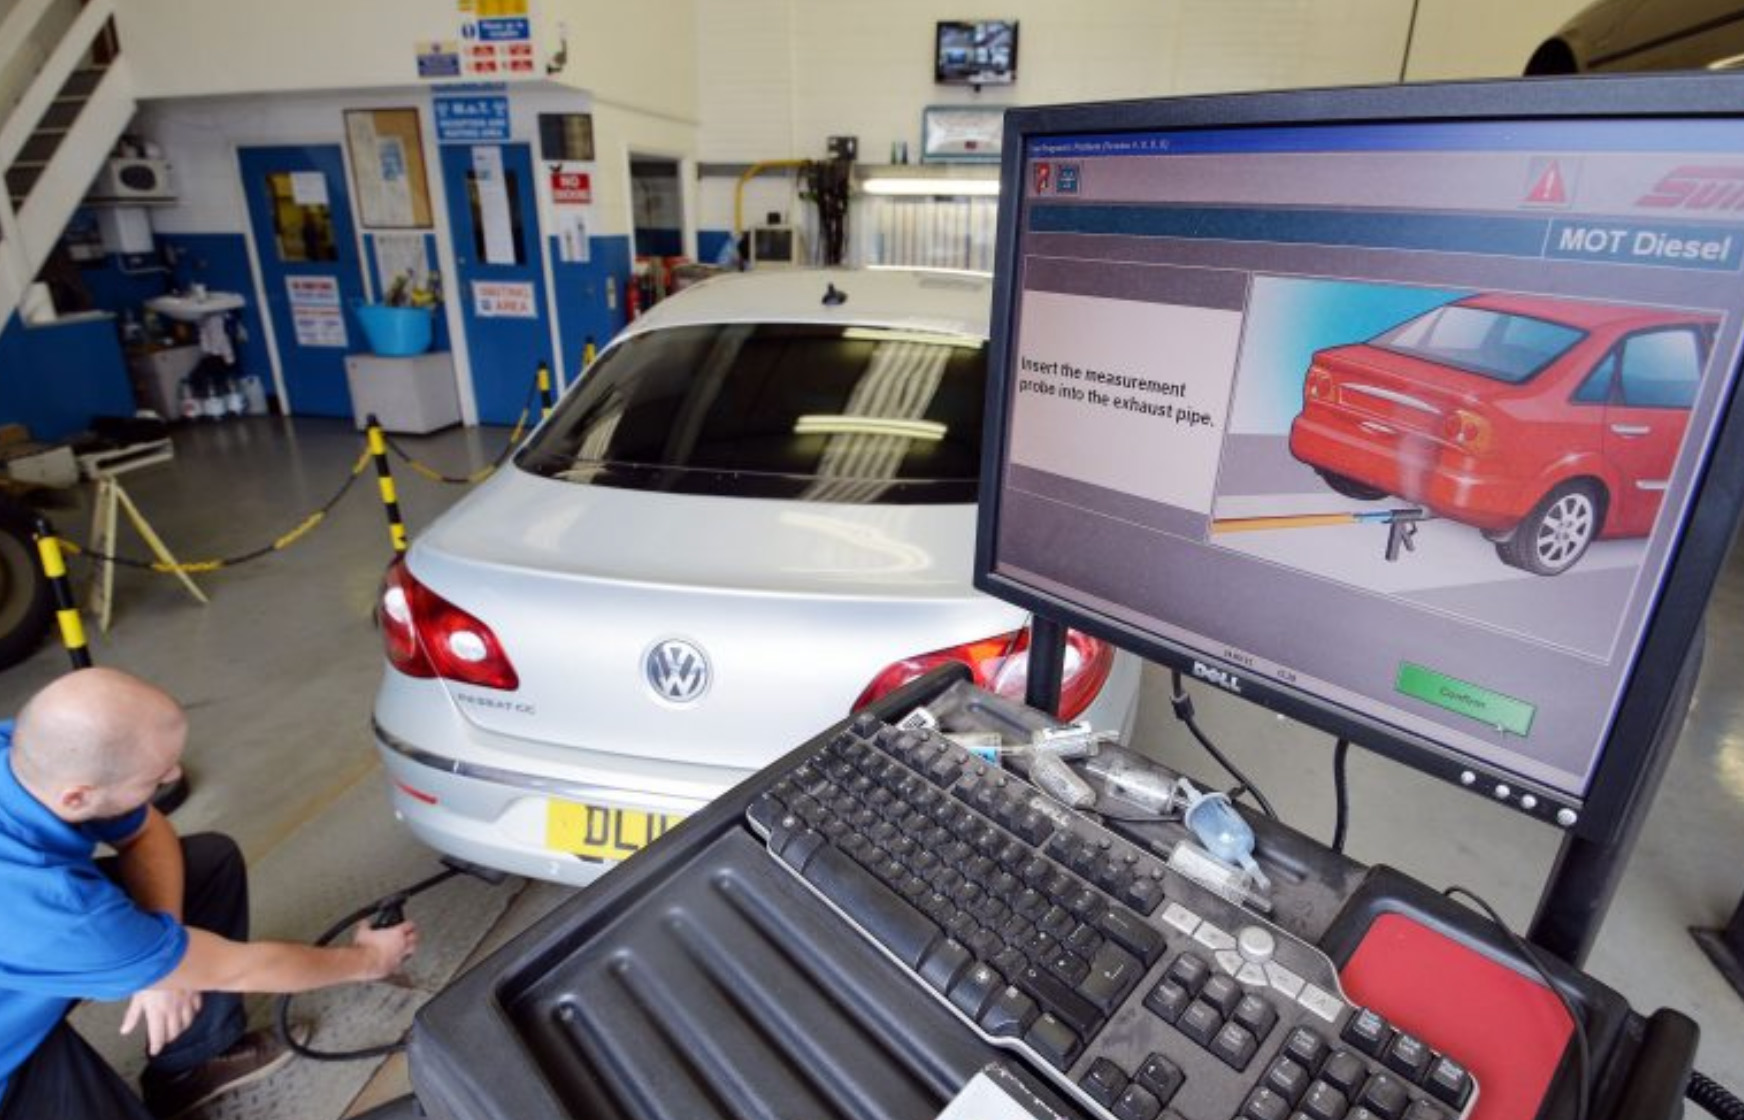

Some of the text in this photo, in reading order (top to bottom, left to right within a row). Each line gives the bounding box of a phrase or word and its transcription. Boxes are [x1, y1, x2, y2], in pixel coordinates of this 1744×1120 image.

[1560, 227, 1732, 261] MOT Diesel
[1021, 357, 1186, 397] Insert the measurement
[1019, 378, 1215, 427] probe into the exhaust pipe.
[1194, 661, 1241, 692] DELL
[1439, 685, 1487, 710] Confirm
